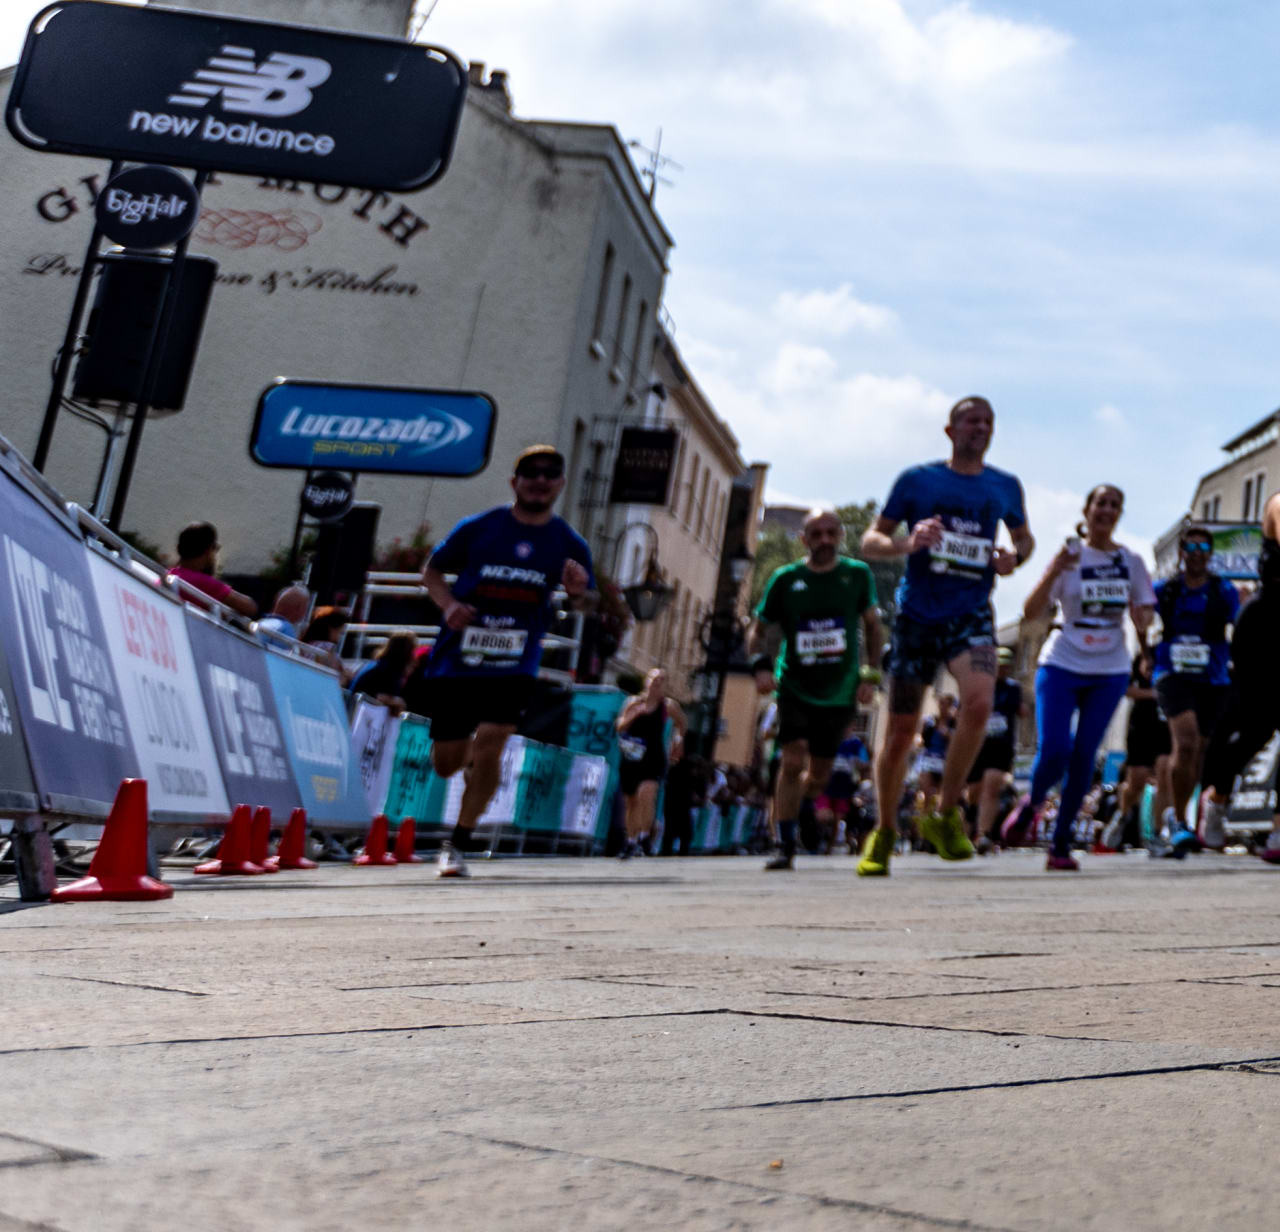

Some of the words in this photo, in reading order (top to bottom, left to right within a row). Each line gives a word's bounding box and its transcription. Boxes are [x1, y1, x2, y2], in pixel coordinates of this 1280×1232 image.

[129, 110, 200, 138] new
[202, 114, 335, 157] balance
[258, 269, 292, 296] &
[292, 263, 422, 297] Kitchen
[280, 406, 446, 445] Lucozade
[313, 440, 402, 457] SPORT
